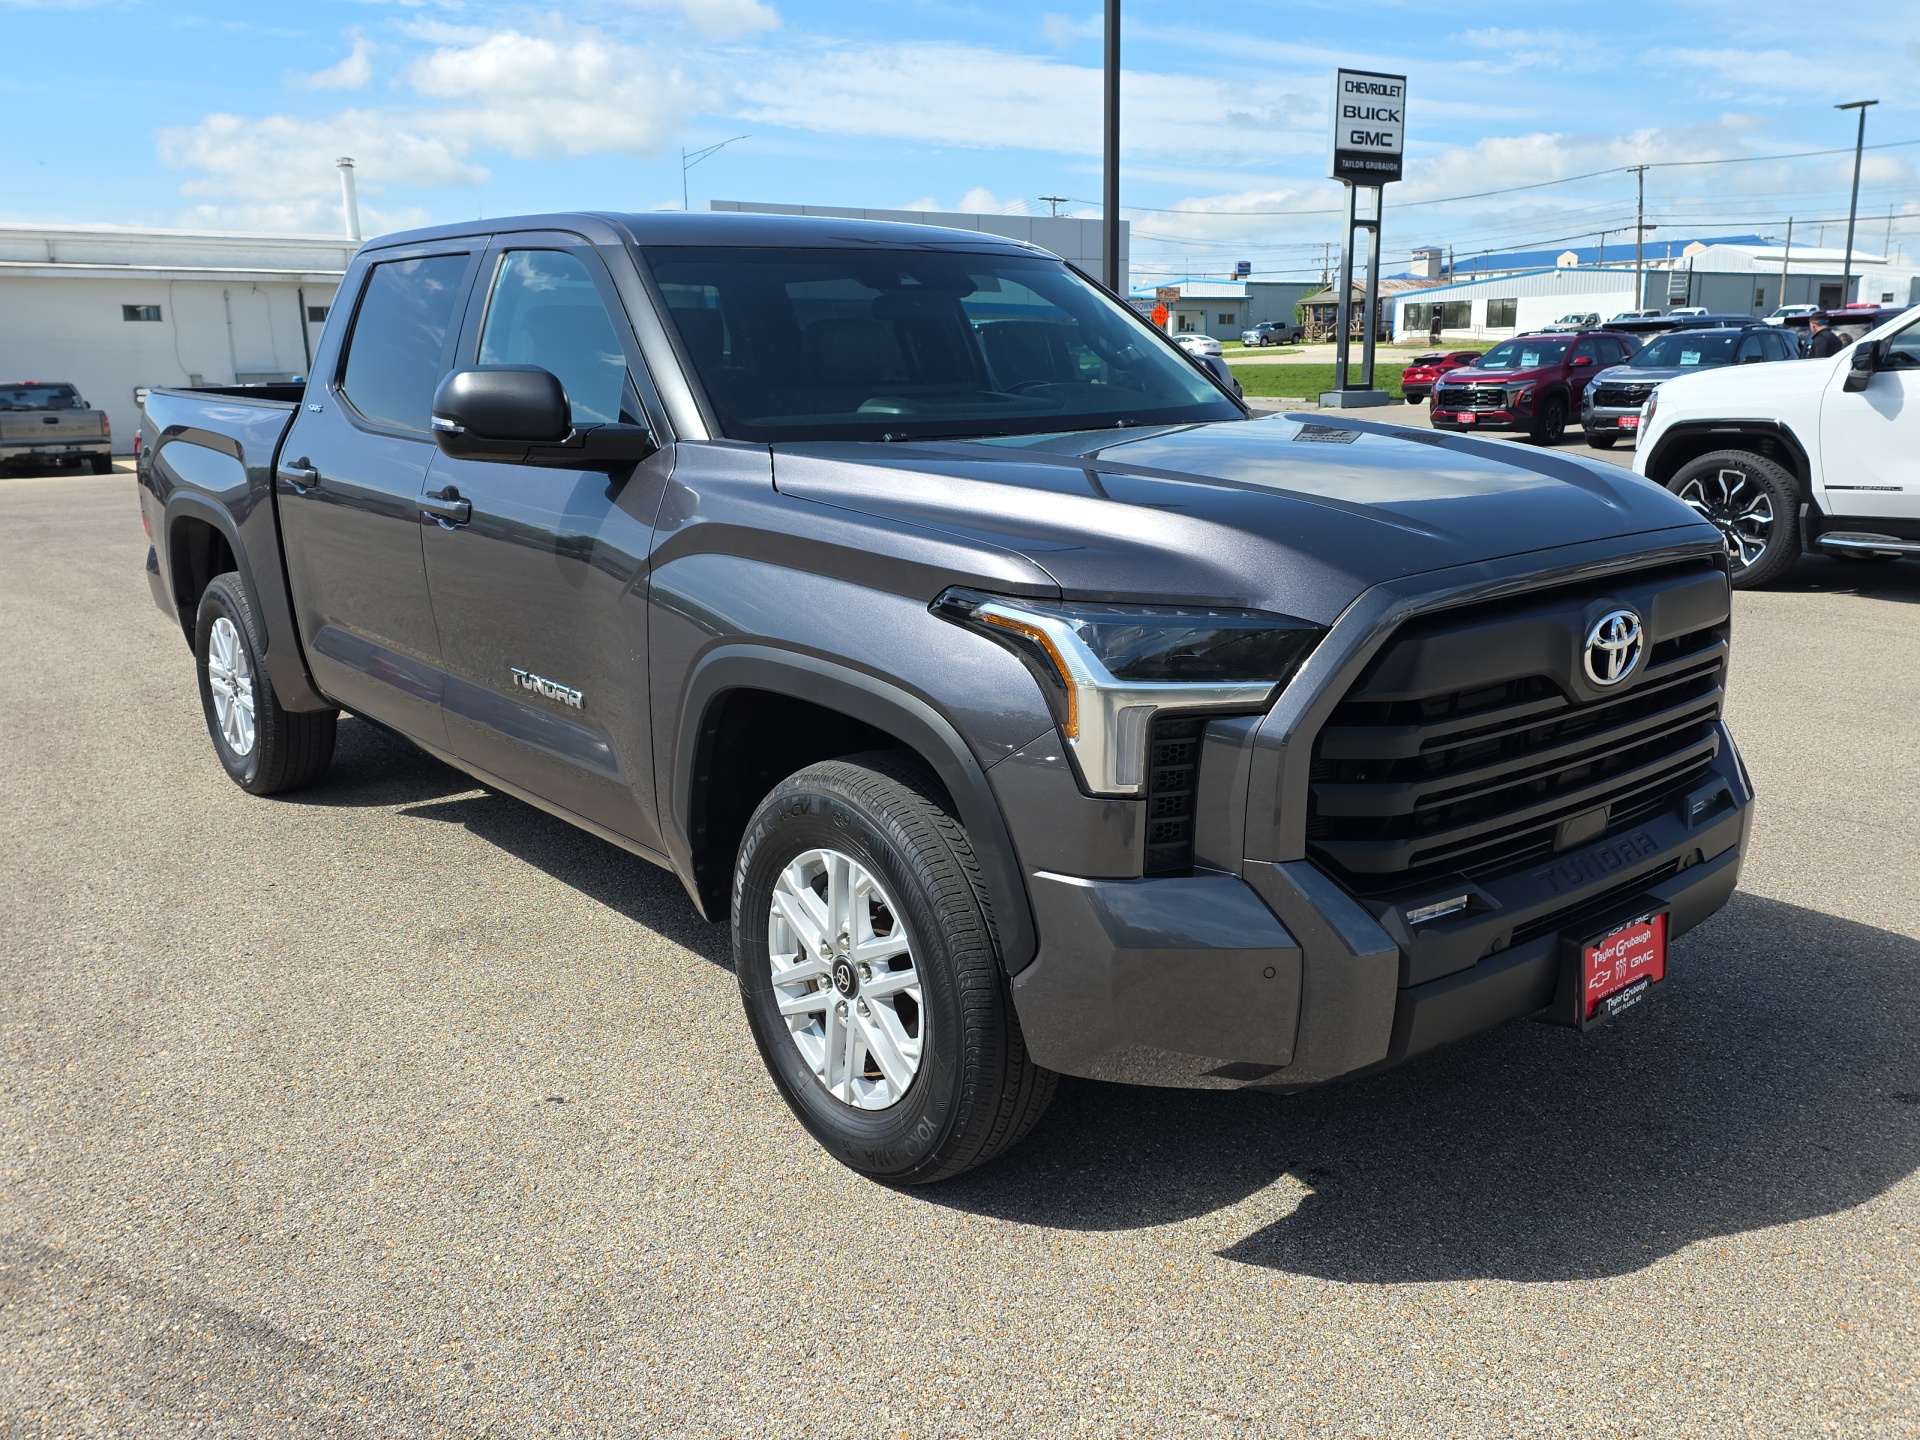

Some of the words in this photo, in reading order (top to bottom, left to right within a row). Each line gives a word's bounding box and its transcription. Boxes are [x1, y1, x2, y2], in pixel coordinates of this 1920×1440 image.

[1345, 80, 1402, 97] CHEVROLET
[1343, 104, 1401, 123] BUICK
[1350, 130, 1393, 147] GMC
[1342, 159, 1364, 169] TAYLOR
[1365, 161, 1398, 171] GRUBAUGH
[510, 667, 583, 709] TUNDRA
[1532, 831, 1659, 892] TUNDRA
[1631, 949, 1654, 968] GMC
